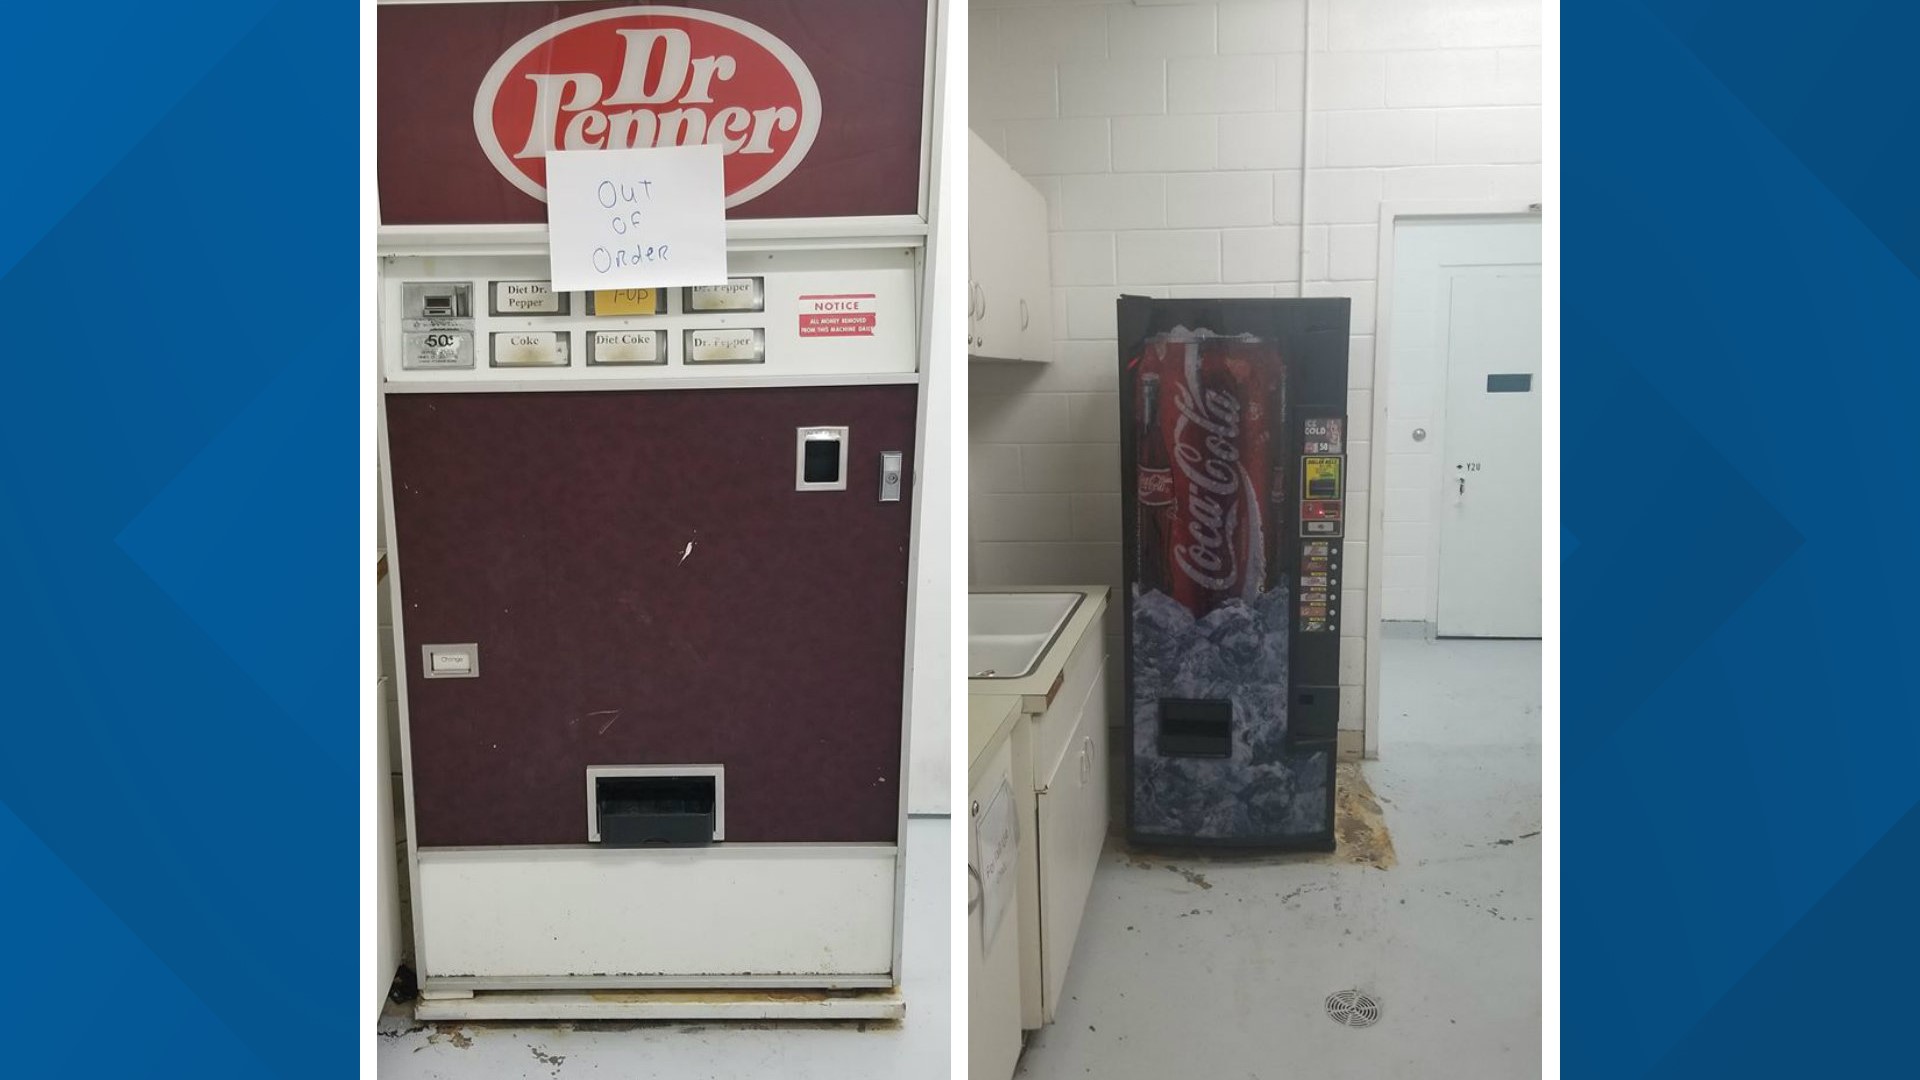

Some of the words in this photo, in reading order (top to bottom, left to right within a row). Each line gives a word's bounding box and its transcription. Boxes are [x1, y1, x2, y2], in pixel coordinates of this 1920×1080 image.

[602, 28, 737, 105] Dr
[513, 72, 798, 159] Pepper
[508, 285, 527, 294] Diet
[531, 285, 548, 294] Dr.
[509, 298, 544, 310] Pepper
[814, 301, 860, 311] NOTICE
[511, 336, 540, 346] Coke
[596, 335, 619, 345] Diet
[622, 334, 651, 345] Coke
[1304, 427, 1327, 435] COLD
[1174, 381, 1241, 590] Coca-Cola
